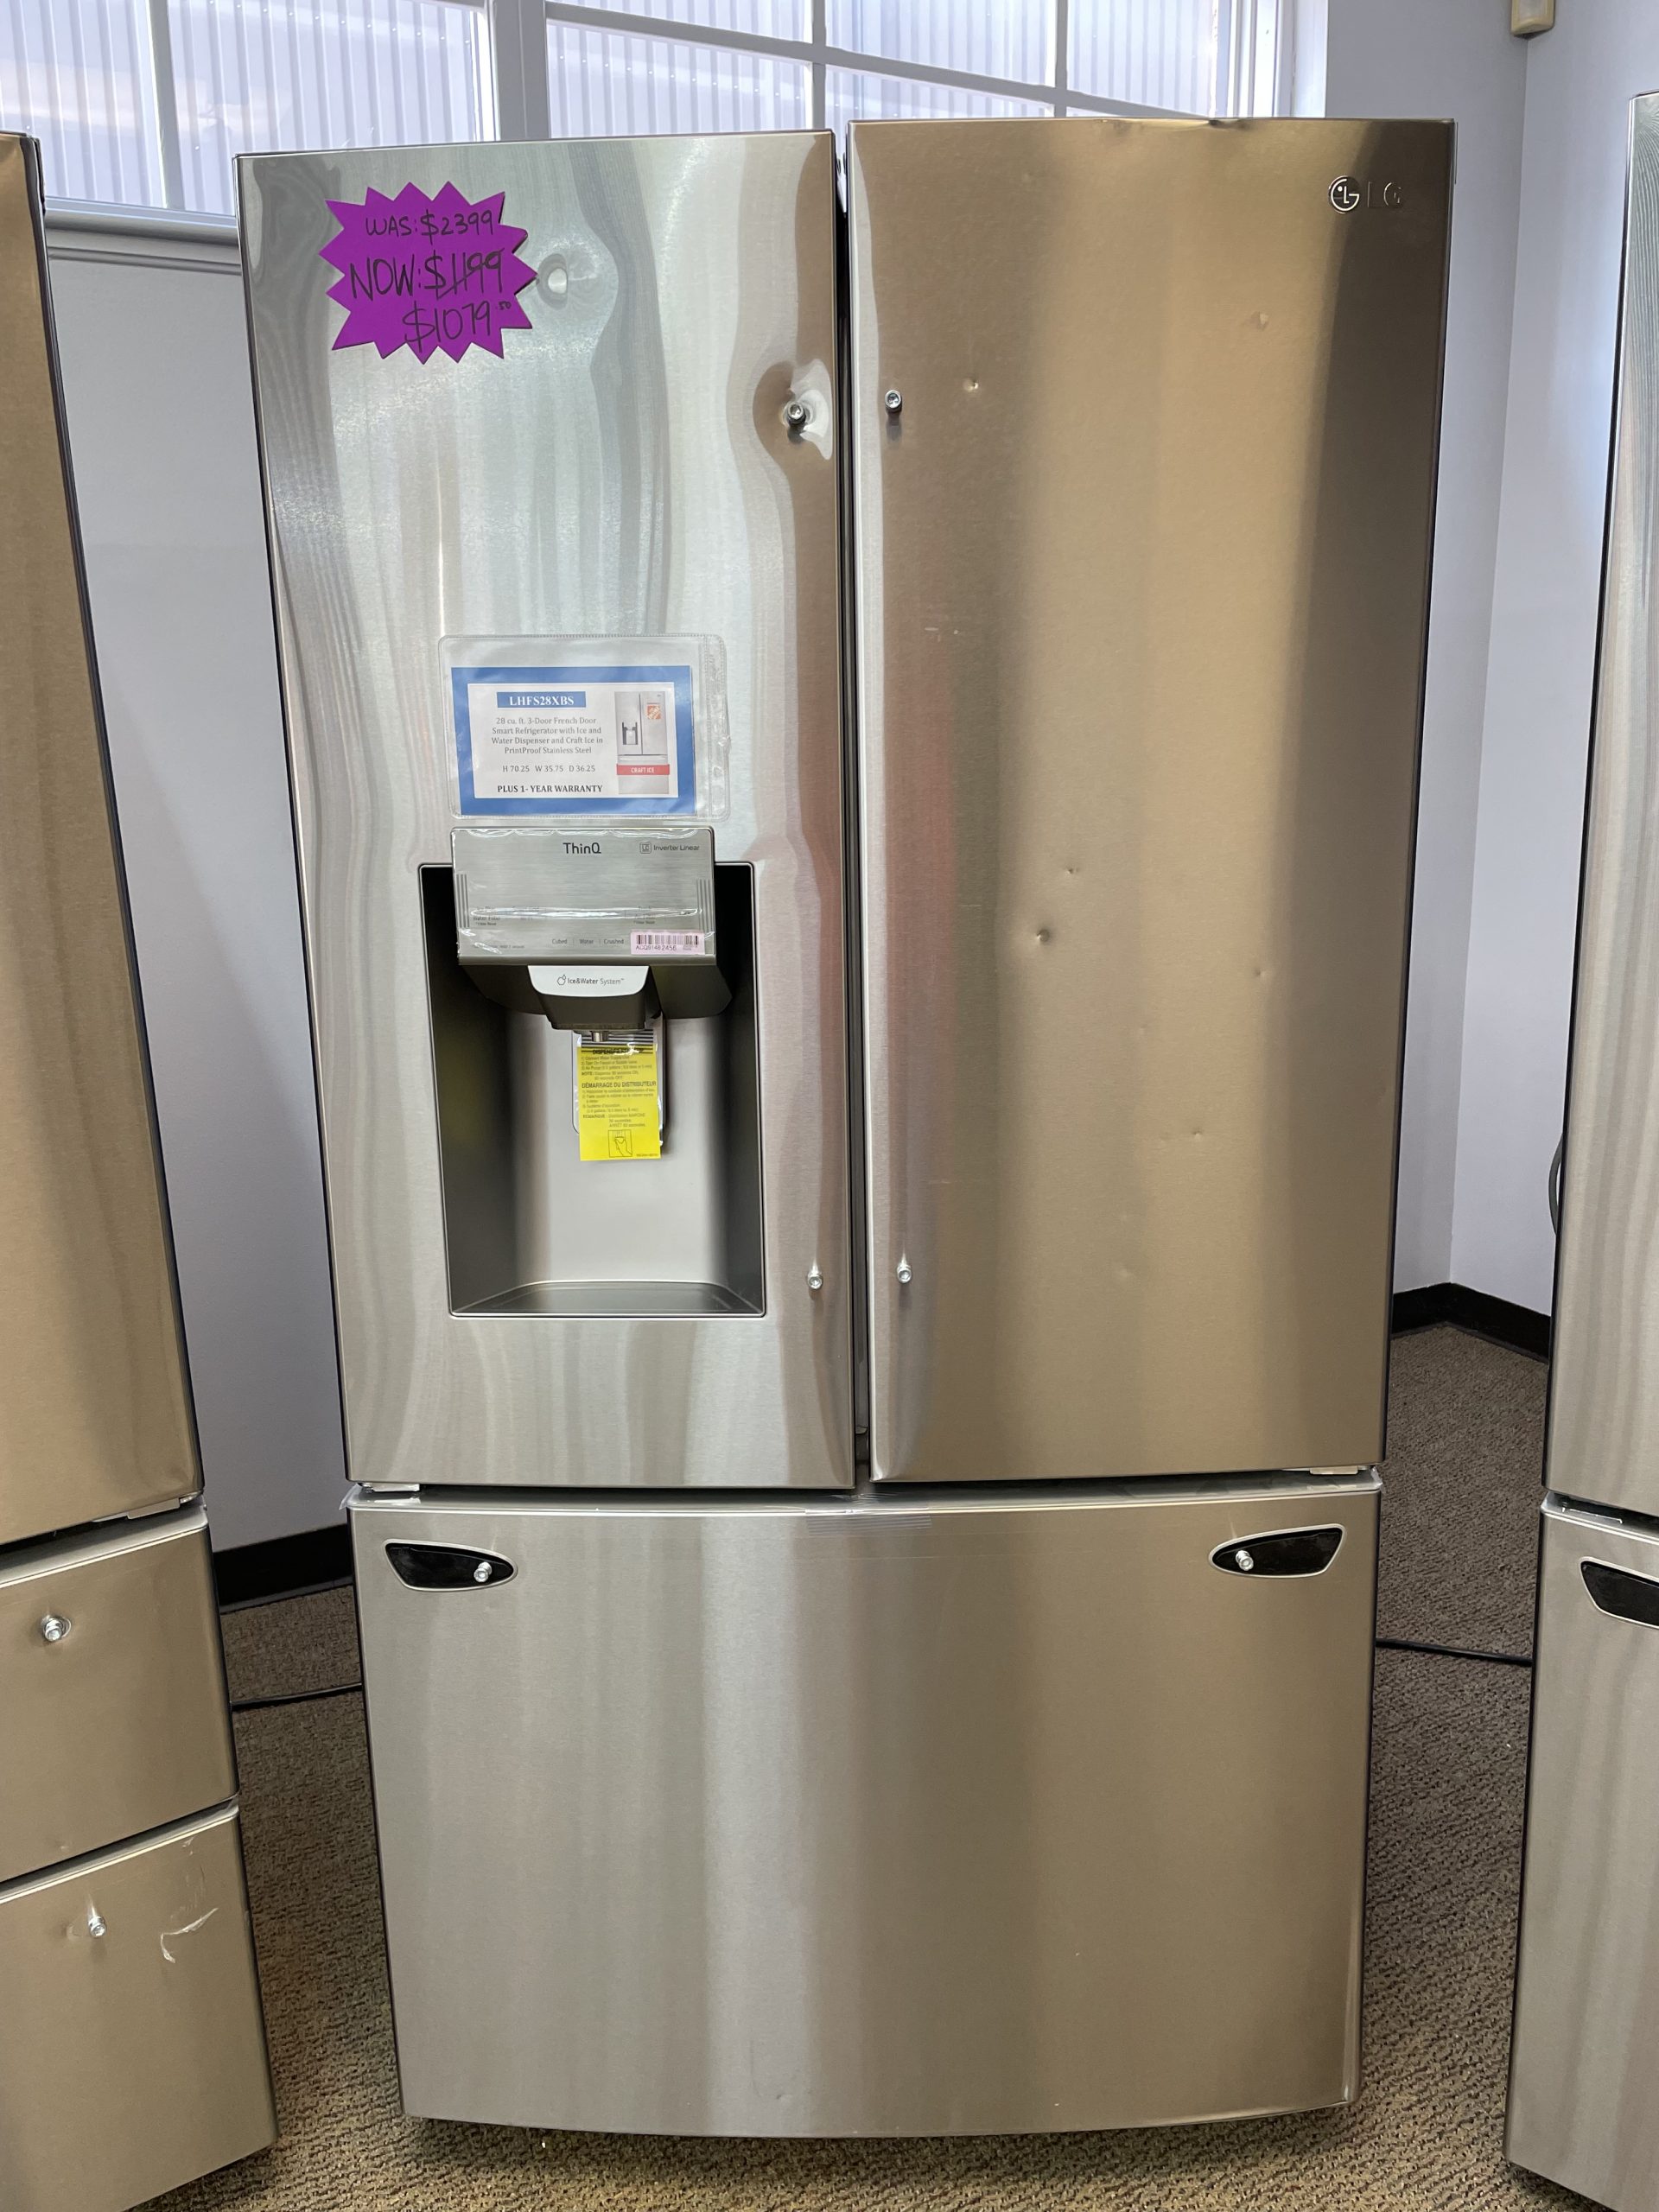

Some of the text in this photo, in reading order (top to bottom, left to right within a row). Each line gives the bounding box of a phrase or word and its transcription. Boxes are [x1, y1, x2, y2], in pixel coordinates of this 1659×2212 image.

[420, 209, 494, 245] $2399
[349, 254, 421, 301] NOW:
[402, 301, 491, 353] $1079
[509, 696, 575, 706] LHFS28XBS
[515, 727, 557, 736] Refrigerator
[514, 737, 550, 746] Dispenser
[563, 842, 601, 854] ThinQ
